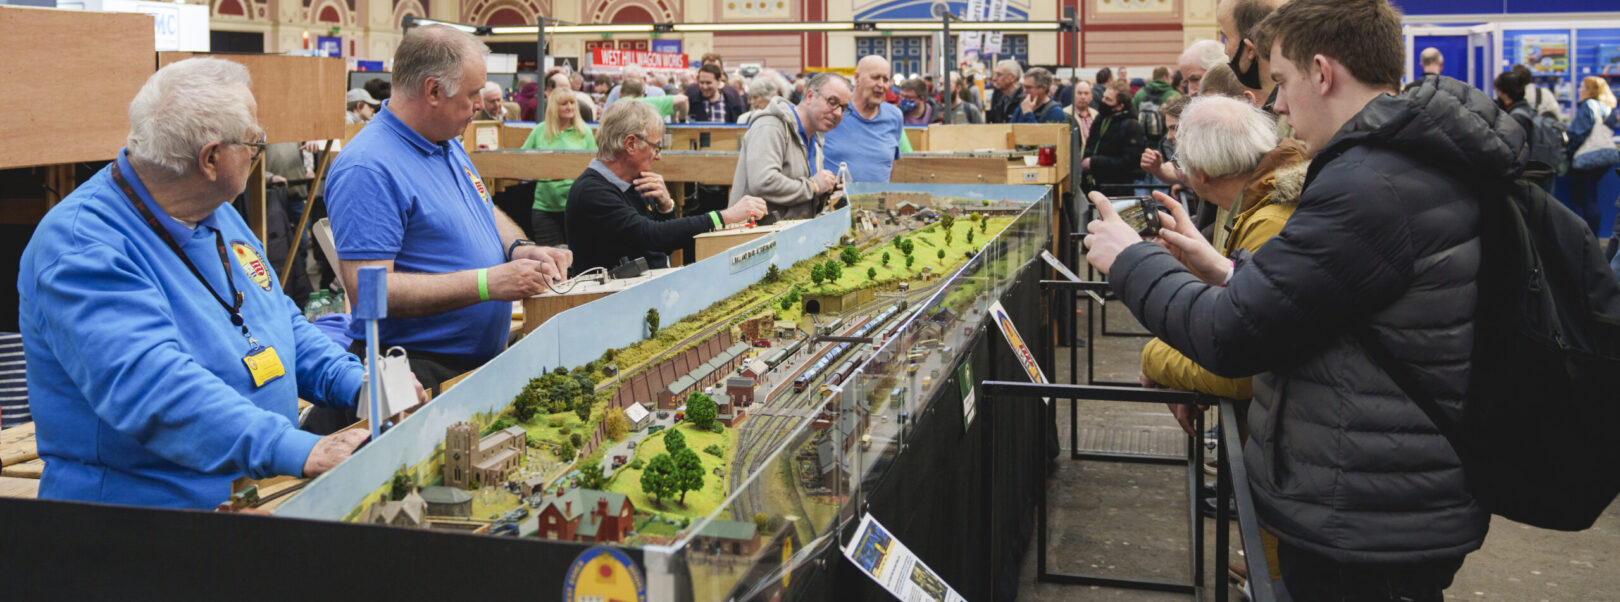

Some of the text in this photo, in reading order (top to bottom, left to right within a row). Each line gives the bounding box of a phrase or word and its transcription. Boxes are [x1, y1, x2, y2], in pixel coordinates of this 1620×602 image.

[601, 49, 684, 69] WEST HILL WAGON WORKS
